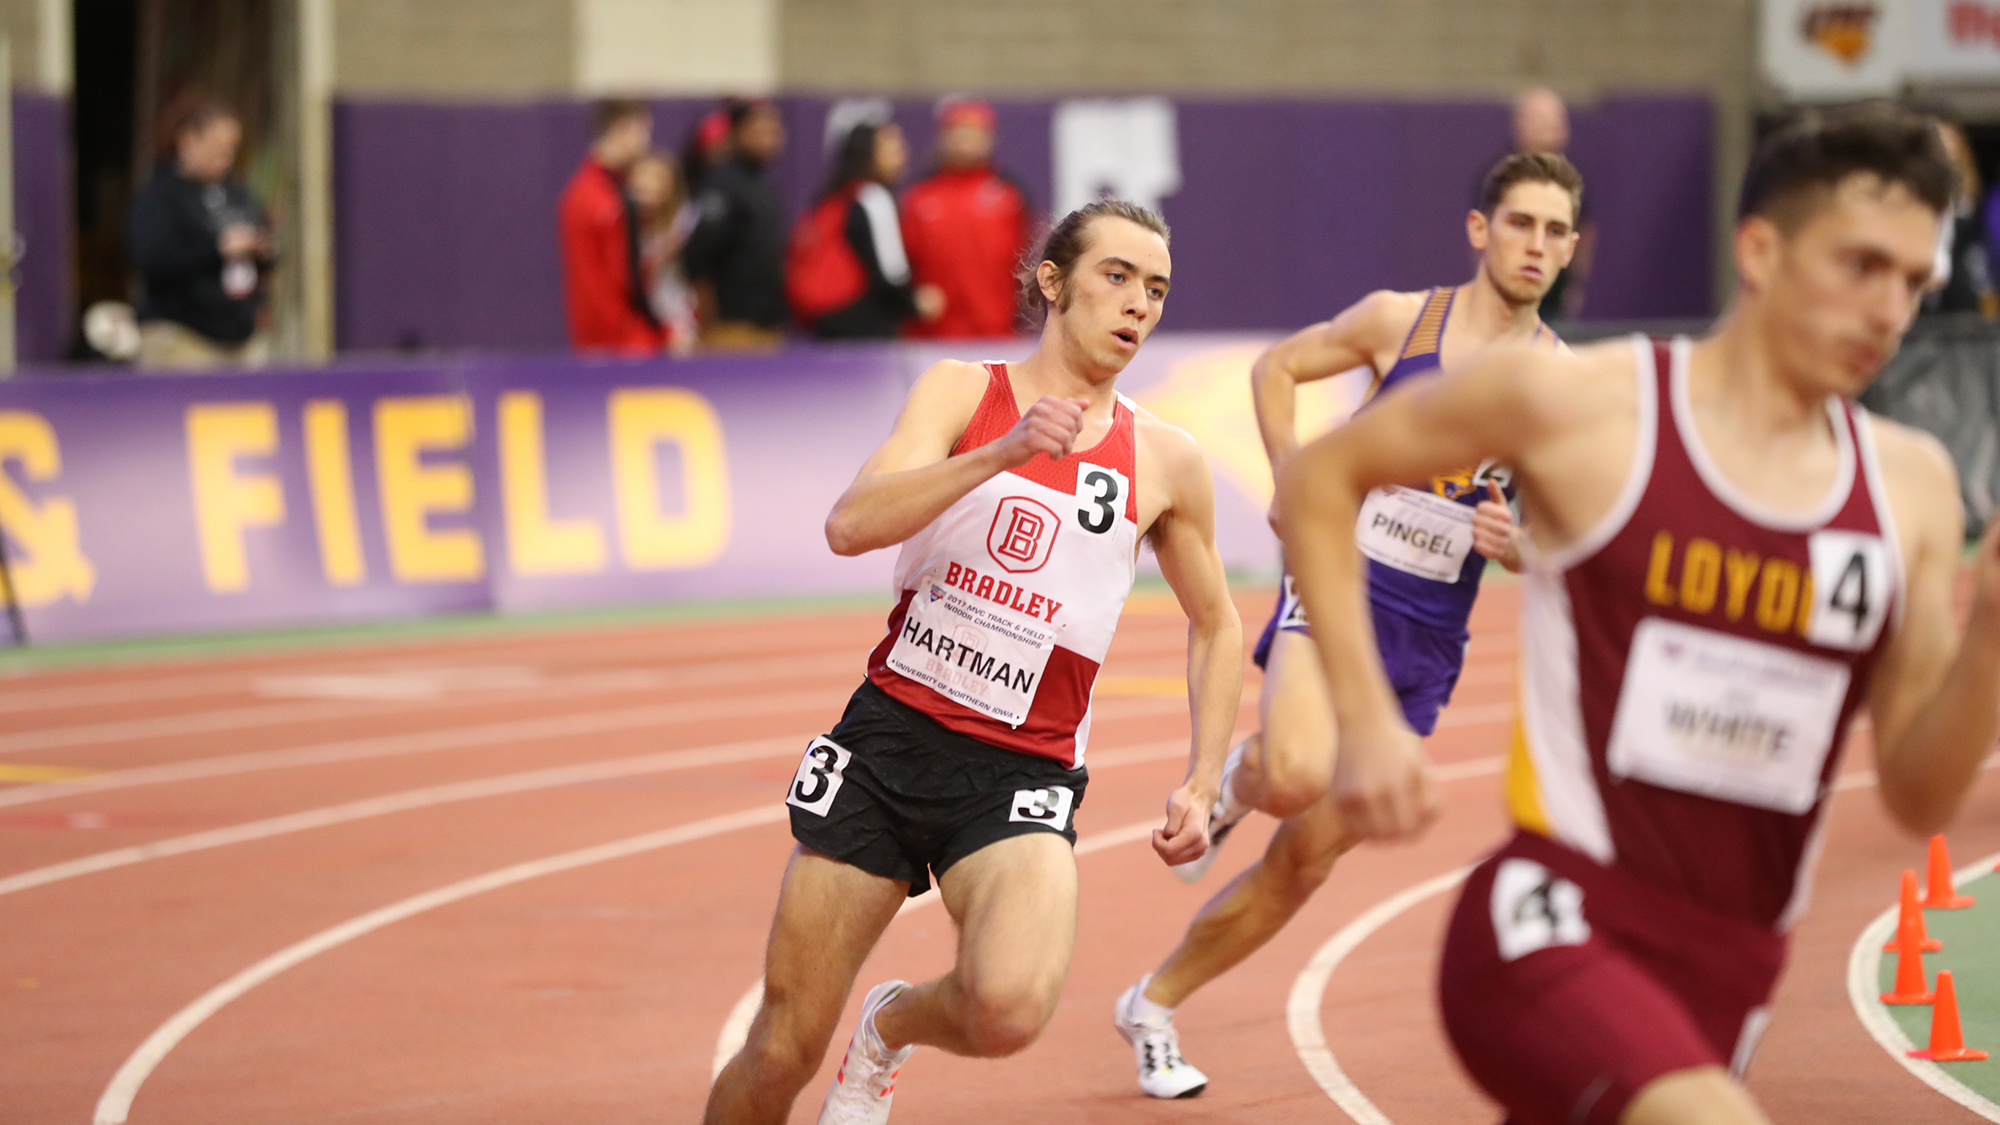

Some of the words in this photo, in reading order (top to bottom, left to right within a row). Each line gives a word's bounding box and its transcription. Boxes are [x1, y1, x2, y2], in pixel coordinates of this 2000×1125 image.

[186, 387, 732, 593] FIELD
[1077, 471, 1118, 534] 3
[997, 506, 1044, 562] B
[1371, 512, 1454, 559] PINGEL
[944, 561, 1063, 624] BRADLEY
[947, 594, 967, 608] 2017
[968, 604, 985, 617] MVC
[987, 613, 1013, 629] TRACK
[1022, 627, 1045, 641] FIELD
[1830, 552, 1868, 632] 4
[903, 616, 1035, 694] HARTMAN
[943, 602, 973, 622] INDOOR
[973, 616, 1042, 650] CHAMPIONSHIPS
[895, 660, 937, 685] UNIVERSITY
[937, 681, 948, 691] OF
[947, 688, 992, 712] NORTHERN
[992, 705, 1014, 720] IOWA
[794, 744, 839, 803] 3
[1016, 786, 1061, 820] 3
